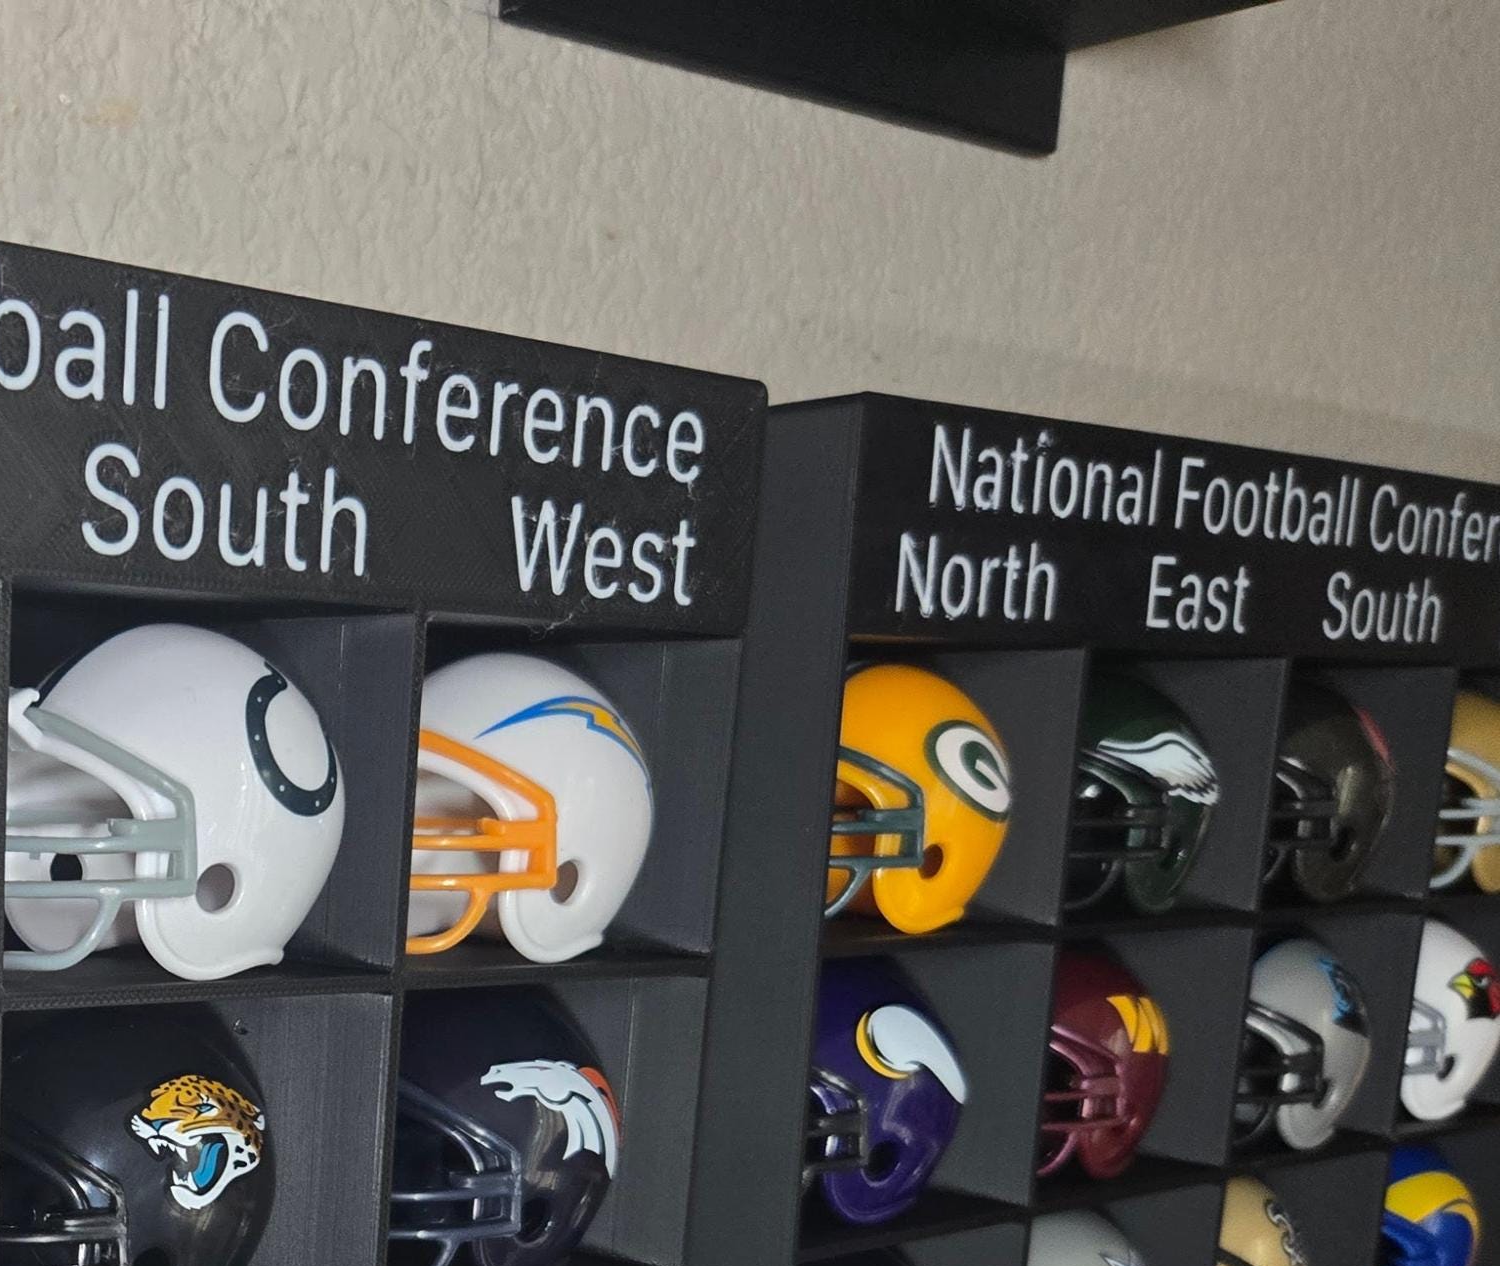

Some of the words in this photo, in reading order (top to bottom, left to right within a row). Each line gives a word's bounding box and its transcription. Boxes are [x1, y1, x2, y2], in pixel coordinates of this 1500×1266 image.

[208, 310, 705, 487] Conference
[80, 442, 368, 578] South
[510, 494, 697, 607] West
[928, 423, 1163, 527] National
[1173, 456, 1361, 548] Football
[1368, 483, 1500, 562] Confer
[894, 531, 1057, 622] North
[1145, 554, 1251, 635] East
[1321, 570, 1442, 644] South
